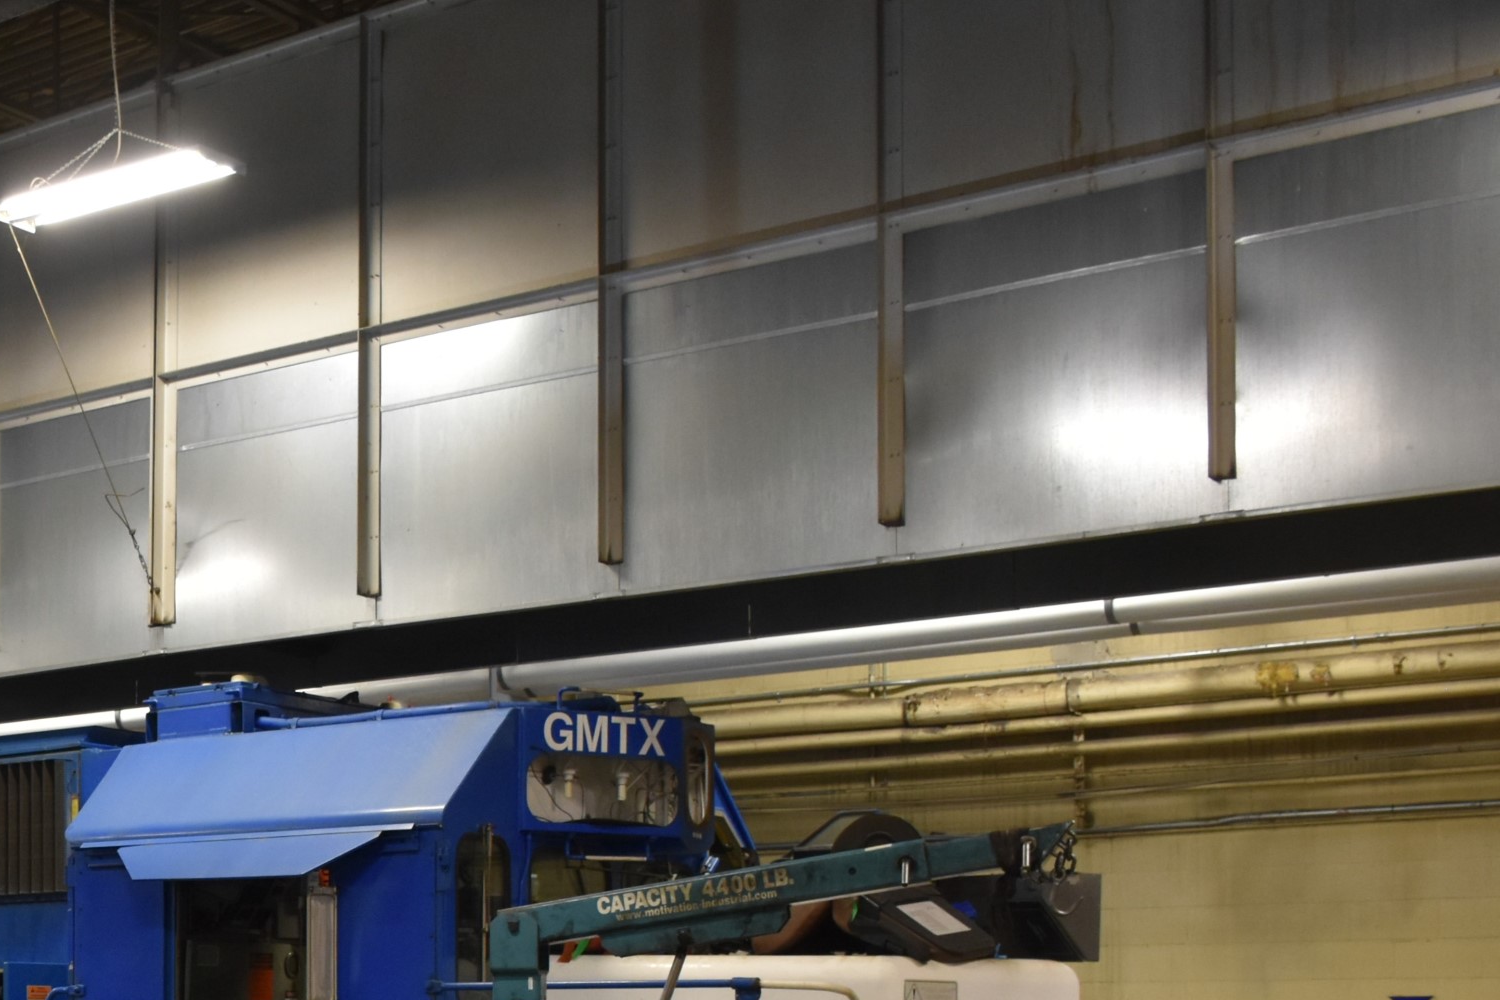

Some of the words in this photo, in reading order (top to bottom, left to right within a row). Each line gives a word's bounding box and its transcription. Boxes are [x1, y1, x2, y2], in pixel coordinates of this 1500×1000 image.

[543, 711, 666, 758] GMTX
[596, 882, 693, 915] CAPACITY
[702, 873, 757, 898] 4400
[761, 867, 795, 889] LB.
